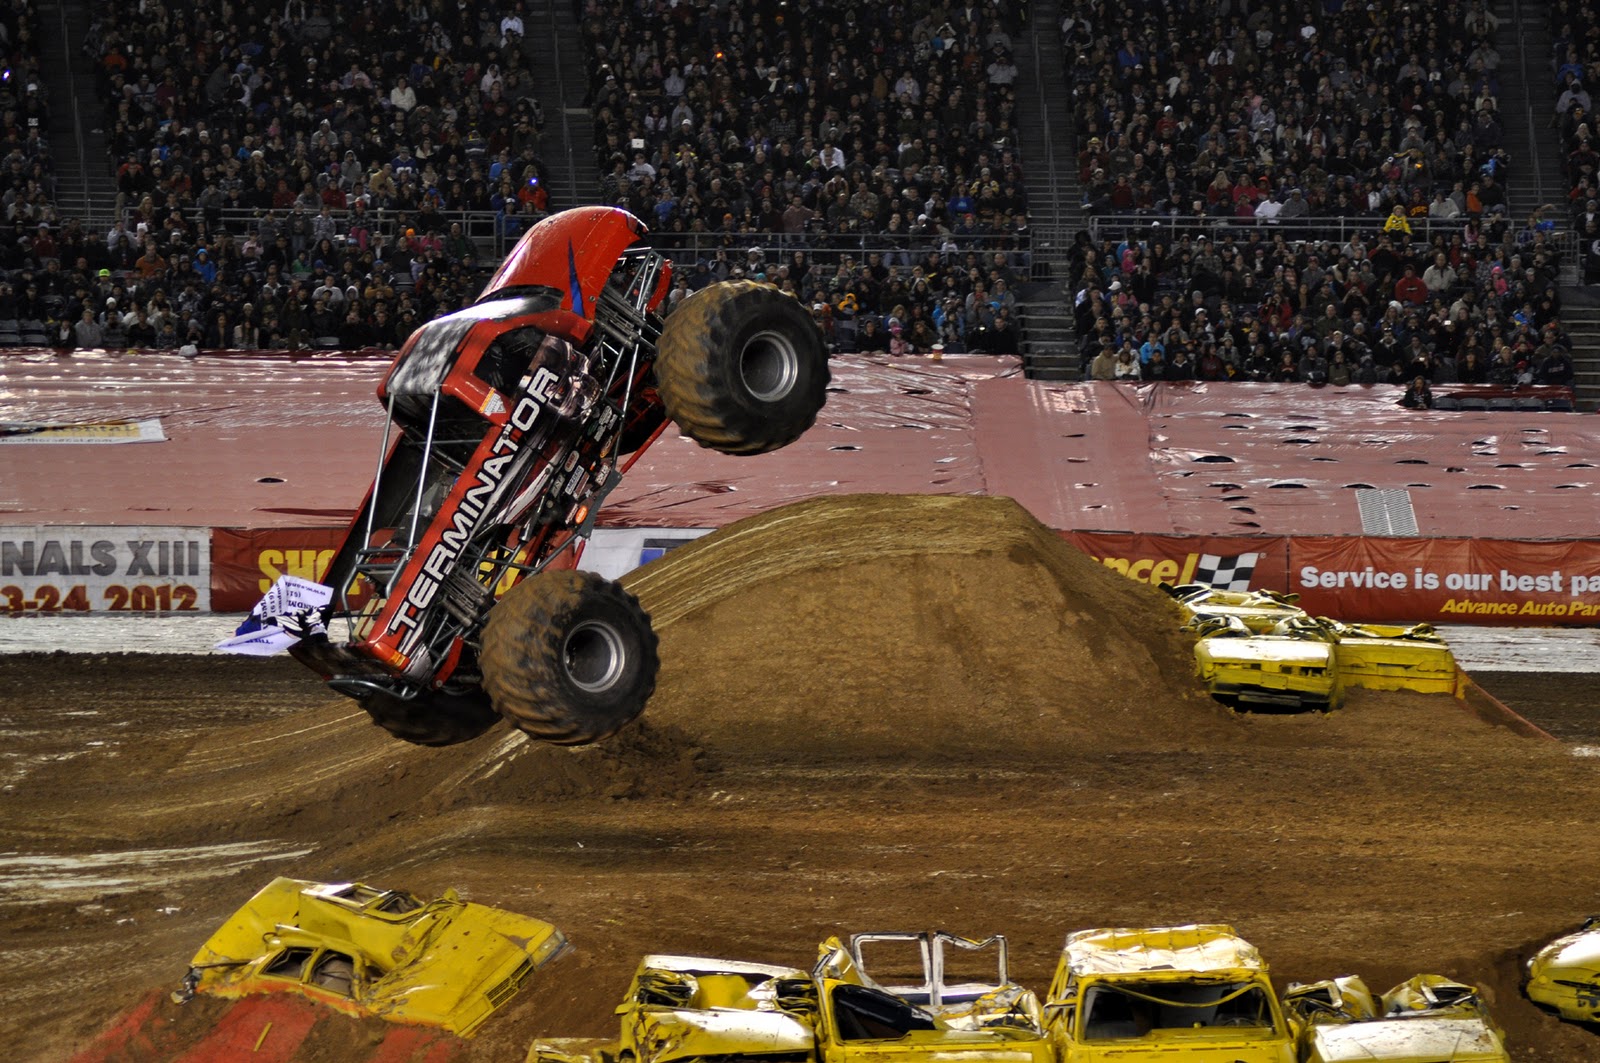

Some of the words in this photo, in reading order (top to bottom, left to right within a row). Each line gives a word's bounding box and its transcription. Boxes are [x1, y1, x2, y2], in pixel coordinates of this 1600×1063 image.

[389, 366, 560, 637] TERMINATOR
[1, 540, 117, 577] NALS
[126, 541, 200, 577] XIII
[1300, 566, 1408, 588] Service
[1415, 567, 1440, 590] is
[1445, 573, 1493, 591] our
[1500, 569, 1563, 592] best
[103, 584, 201, 612] 2012
[1440, 599, 1518, 614] Advance
[1518, 601, 1567, 616] Auto
